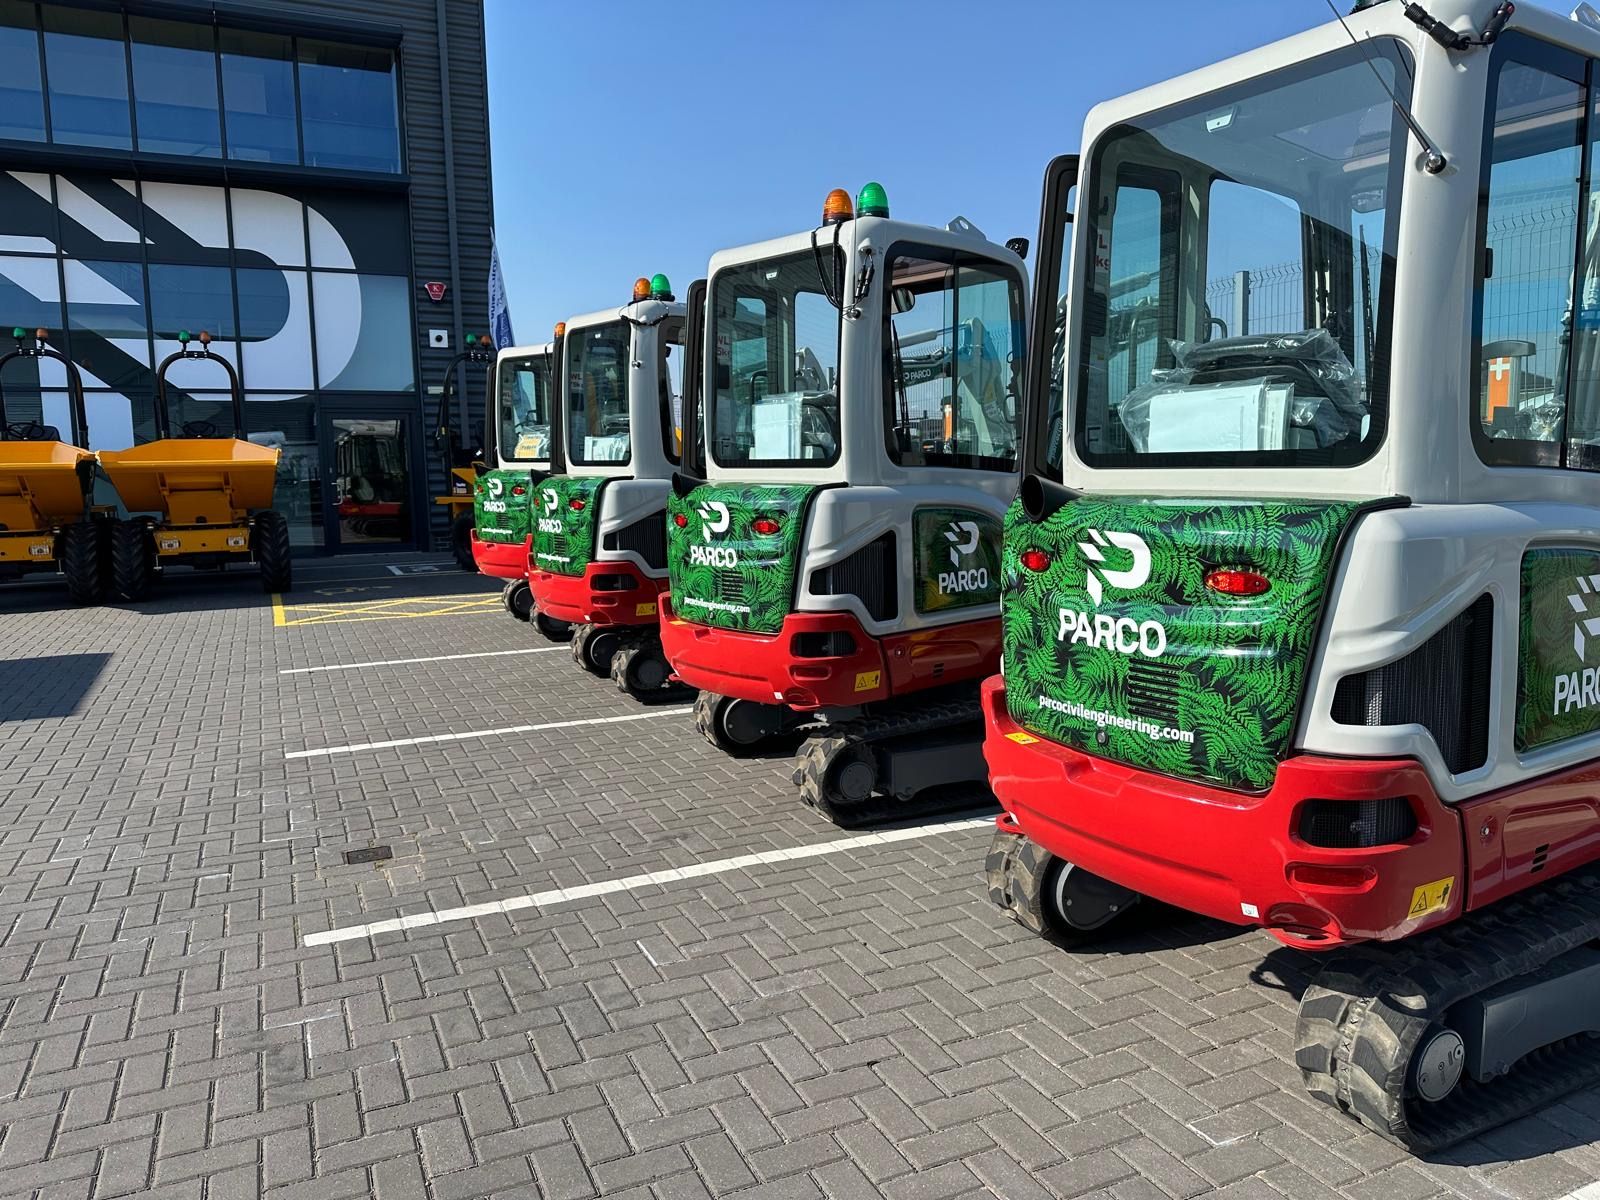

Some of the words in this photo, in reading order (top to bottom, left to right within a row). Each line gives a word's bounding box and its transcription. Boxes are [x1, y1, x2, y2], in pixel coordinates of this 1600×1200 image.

[910, 368, 931, 381] PARCO
[538, 518, 563, 534] PARCO
[690, 545, 737, 569] PARCO
[938, 567, 988, 595] PARCO
[1057, 608, 1167, 658] PARCO
[1038, 694, 1195, 744] parcocivilengineering.com
